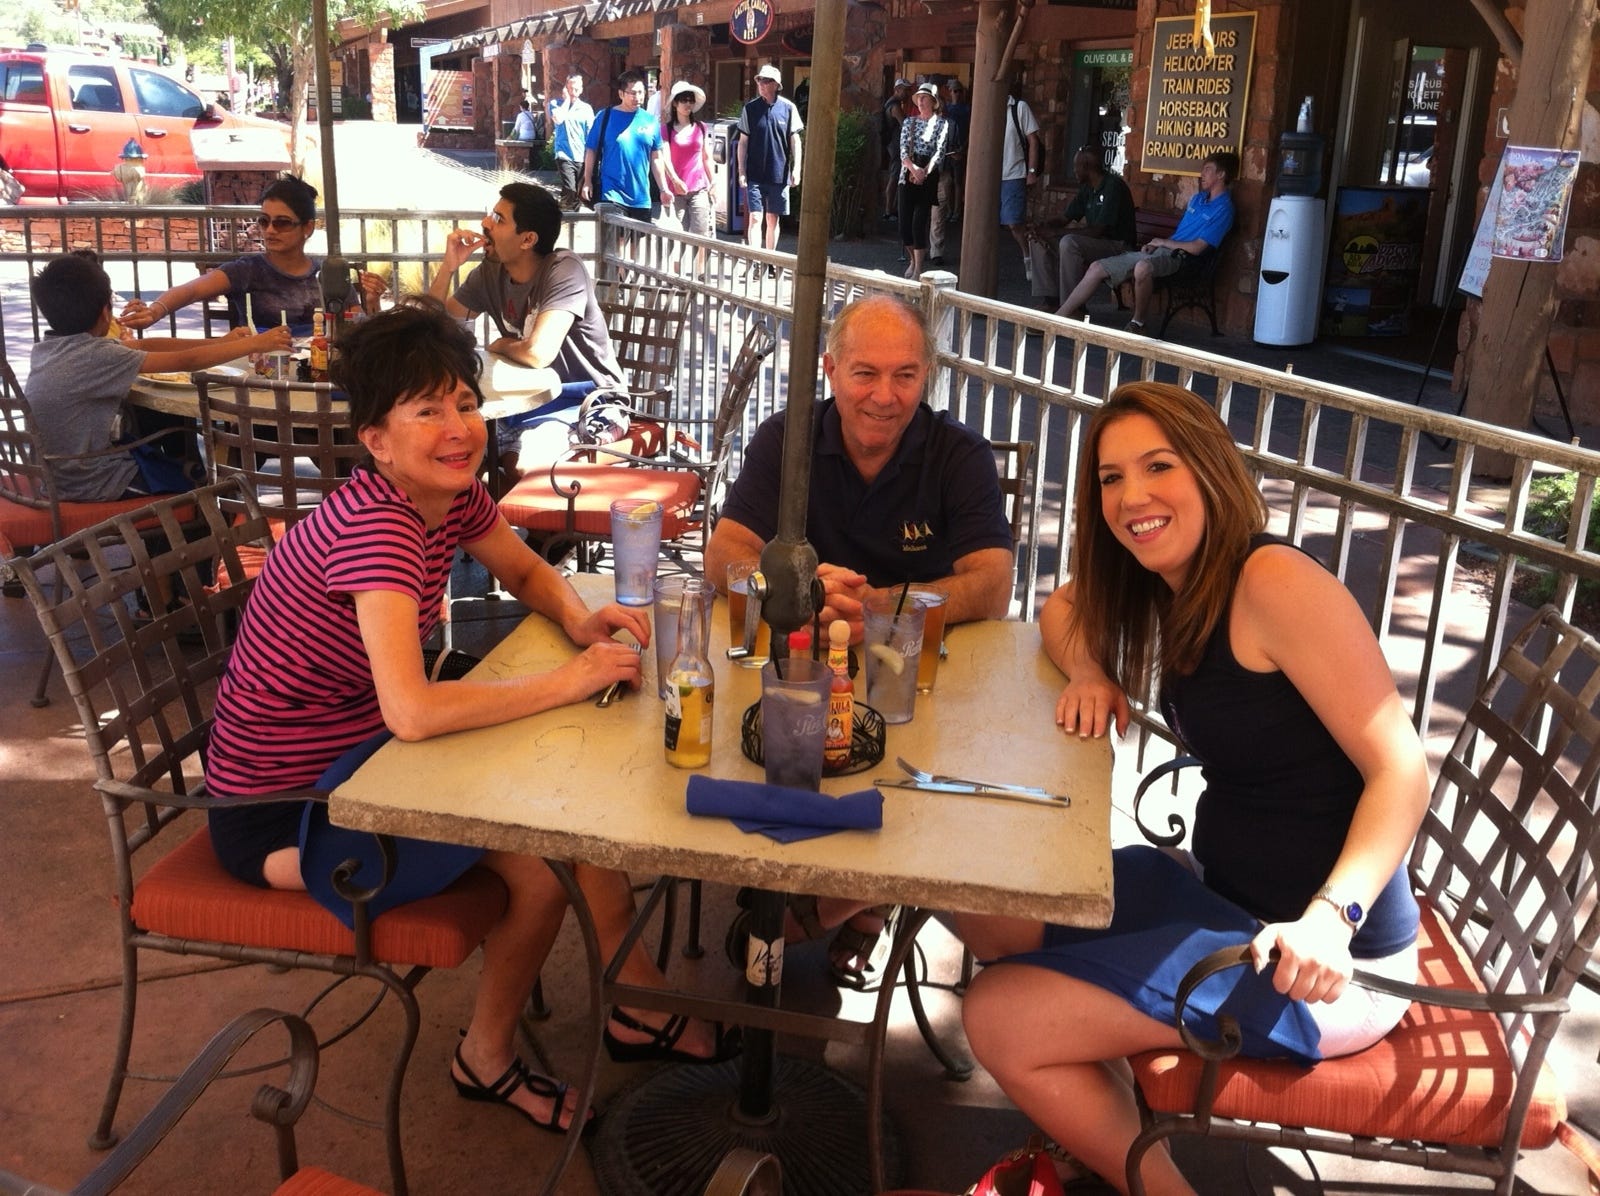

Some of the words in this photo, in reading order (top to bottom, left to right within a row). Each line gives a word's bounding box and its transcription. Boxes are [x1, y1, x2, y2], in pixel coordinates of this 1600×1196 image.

[743, 28, 758, 41] BEST
[1166, 33, 1194, 50] JEEP
[1083, 53, 1105, 64] OLIVE
[1106, 53, 1119, 63] OIL
[1120, 53, 1127, 63] &
[1164, 54, 1235, 72] HELICOPTER
[1162, 78, 1194, 95] TRAIN
[1196, 78, 1231, 95] RIDES
[1159, 101, 1230, 118] HORSEBACK
[1156, 120, 1192, 137] HIKING
[1194, 121, 1228, 138] MAPS
[1146, 141, 1183, 158] GRAND
